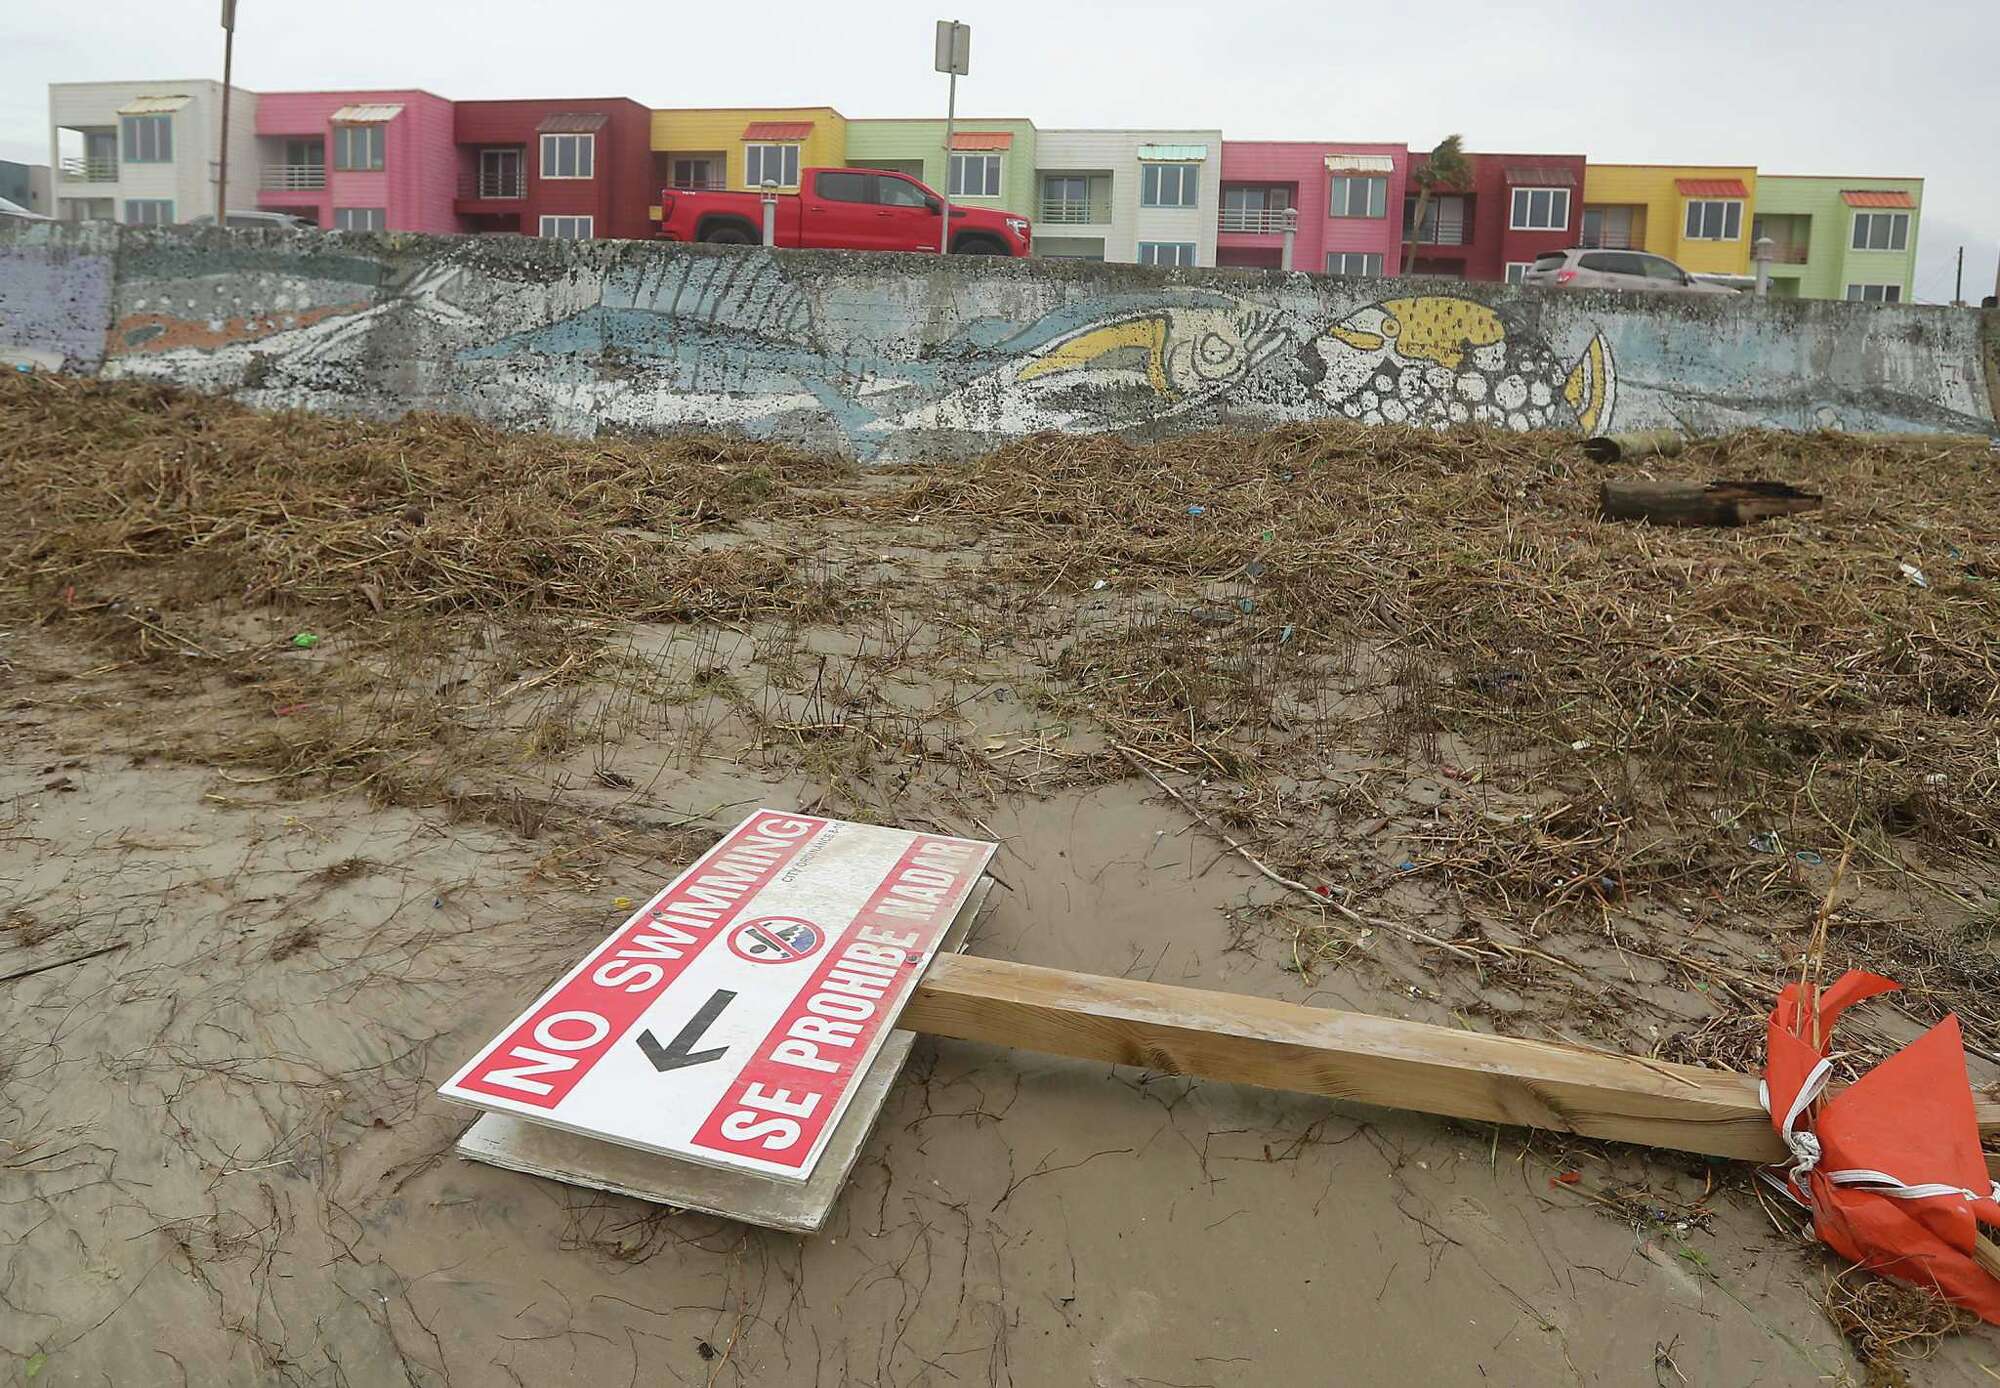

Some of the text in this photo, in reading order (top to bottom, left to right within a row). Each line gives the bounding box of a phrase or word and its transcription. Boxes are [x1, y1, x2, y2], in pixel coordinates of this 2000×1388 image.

[481, 818, 814, 1096] NO SWIMMING
[720, 842, 975, 1151] SE PROHIBE NADAR
[781, 866, 803, 882] CITY
